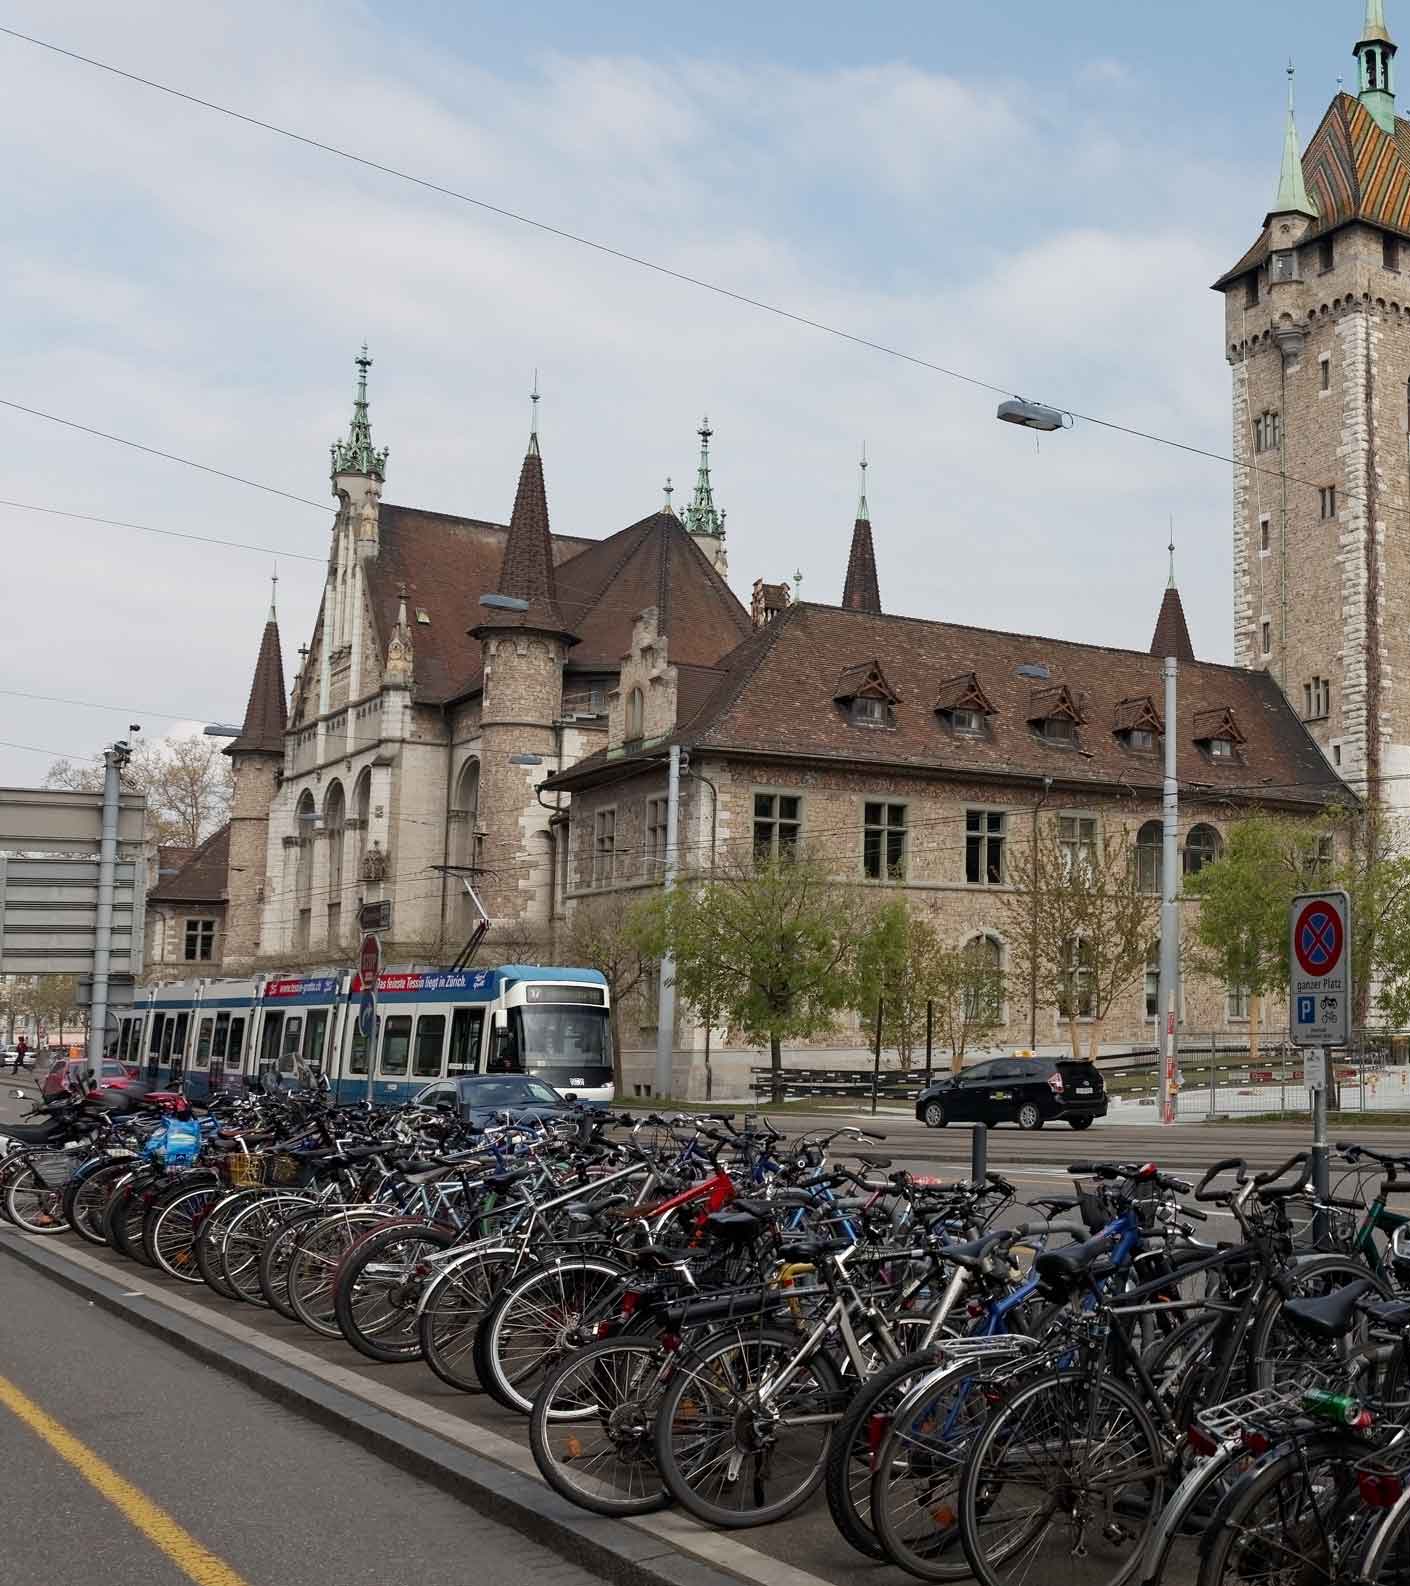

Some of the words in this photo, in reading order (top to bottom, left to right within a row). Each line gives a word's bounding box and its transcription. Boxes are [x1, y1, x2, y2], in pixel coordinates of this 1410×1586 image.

[406, 976, 425, 989] Tessin
[425, 976, 439, 990] liegt
[439, 976, 446, 989] in
[446, 974, 466, 989] Zürich.
[1297, 981, 1321, 992] ganzer
[1323, 977, 1341, 989] Platz
[1301, 1000, 1311, 1021] P
